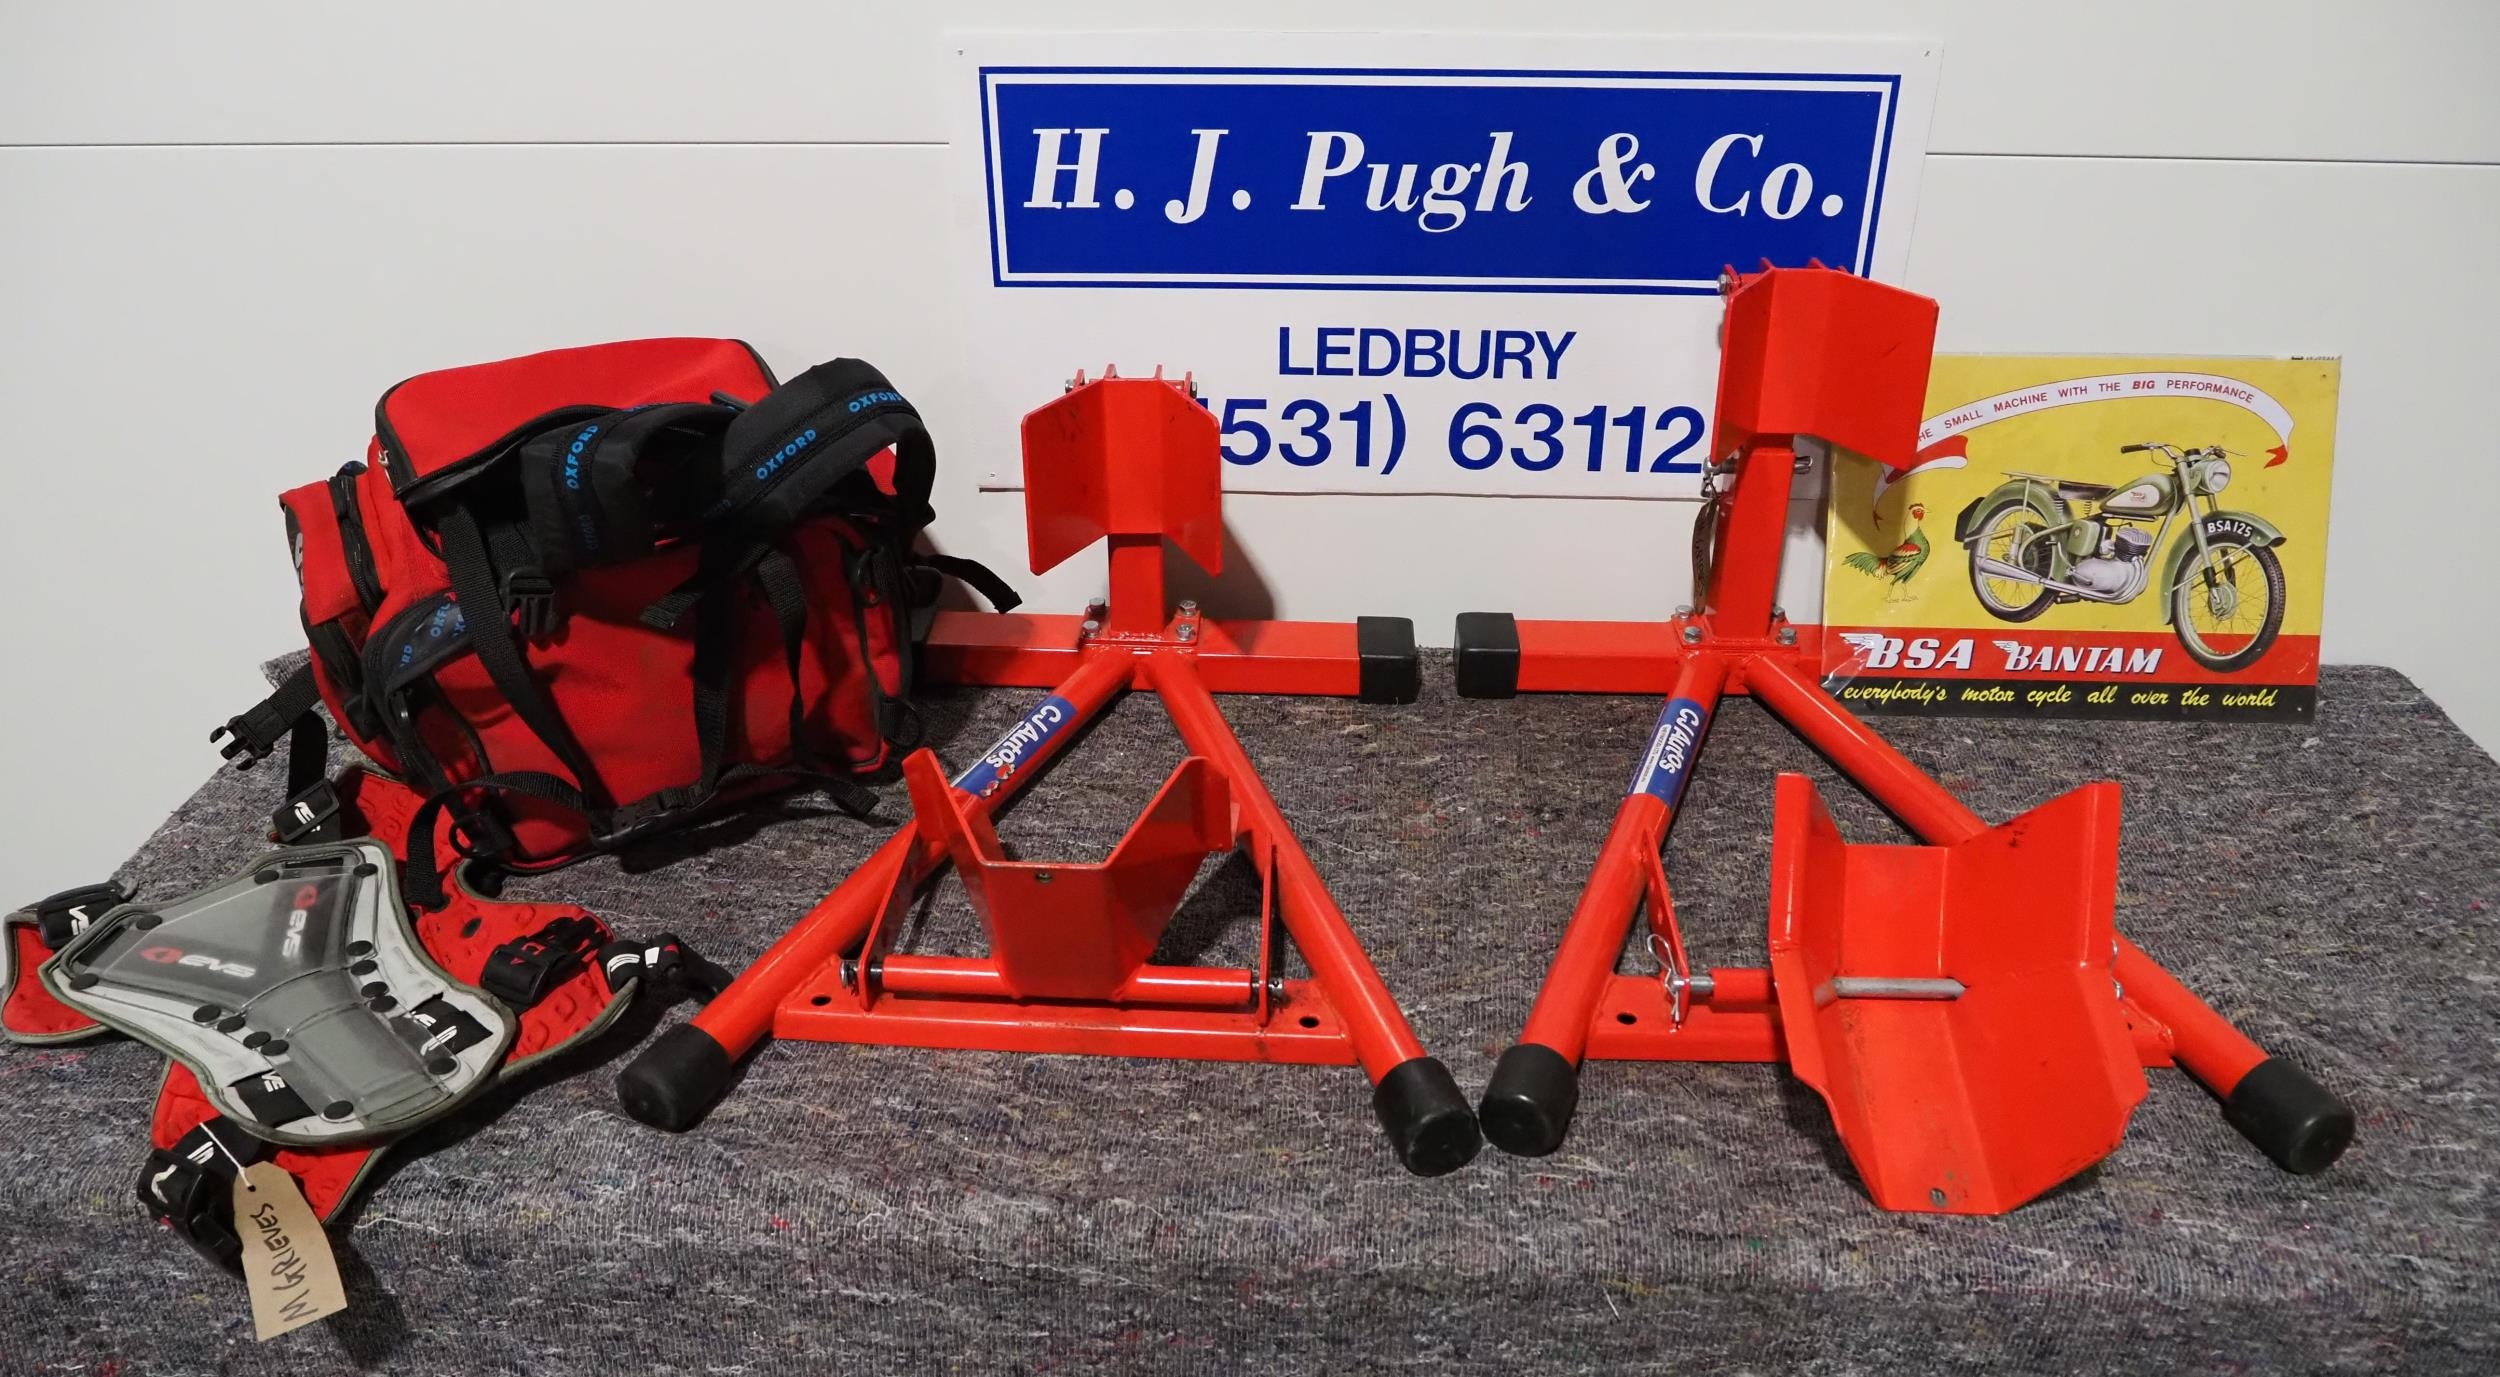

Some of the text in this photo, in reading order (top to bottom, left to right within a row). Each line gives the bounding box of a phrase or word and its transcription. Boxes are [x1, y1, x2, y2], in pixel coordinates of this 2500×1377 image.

[1023, 128, 1844, 233] H. J. Pugh & Co.
[1279, 326, 1576, 380] LEDBURY
[1195, 393, 1407, 475] 531)
[1918, 379, 2255, 441] HE SMALL MACHINE WITH THE BIG PERFORMANCE
[564, 424, 599, 490] OXFORD
[756, 428, 817, 480] OXFORD
[1858, 633, 2164, 674] BSA BANTAM
[1843, 680, 2279, 708] everybody's motor cycle all over the world
